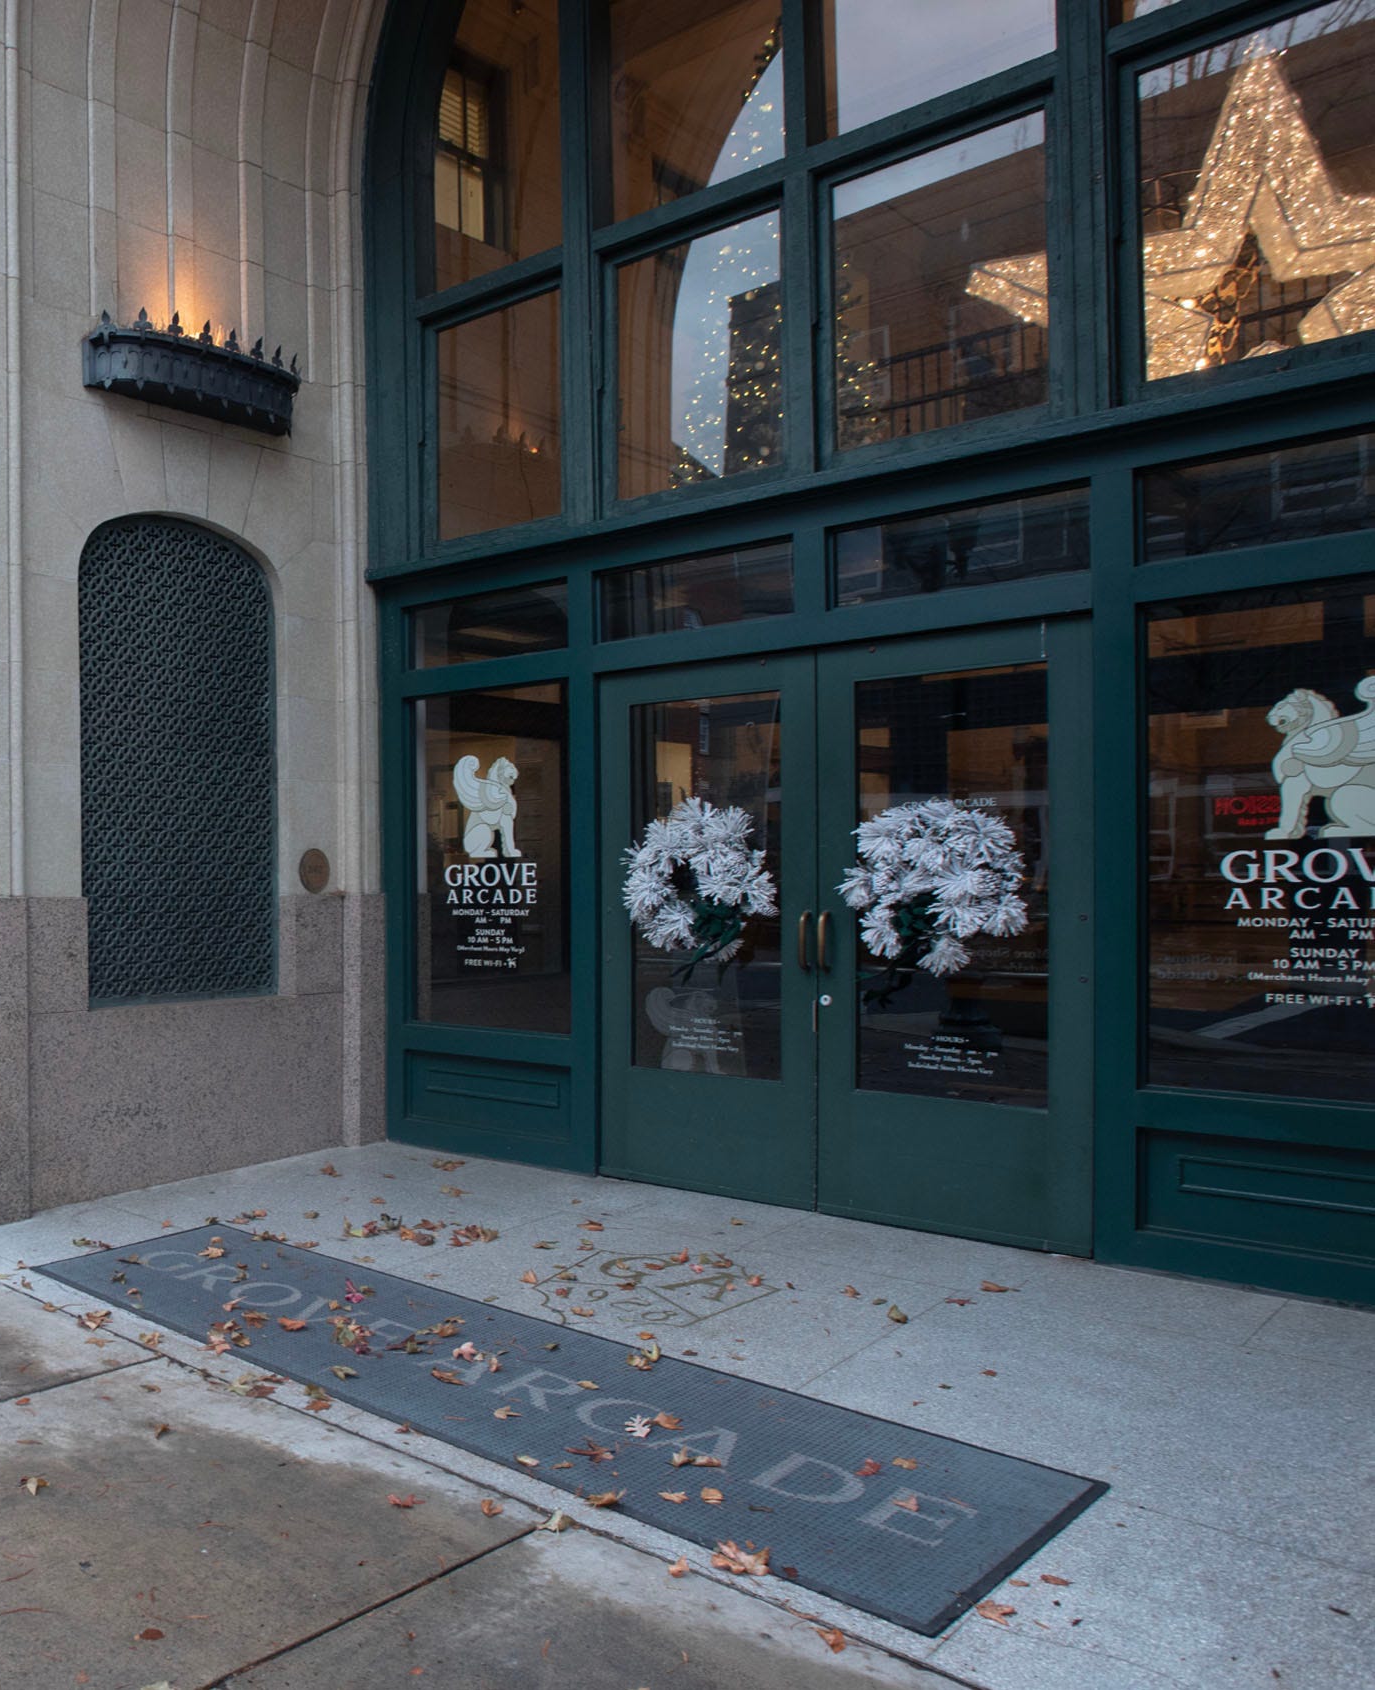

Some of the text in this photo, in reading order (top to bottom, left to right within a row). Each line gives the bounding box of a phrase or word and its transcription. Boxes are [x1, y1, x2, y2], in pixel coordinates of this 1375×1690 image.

[949, 797, 998, 808] RCADE
[444, 863, 537, 887] GROVE
[446, 889, 537, 904] ARCADE
[1223, 887, 1375, 910] ARCA
[1237, 917, 1310, 928] MONDAY
[1289, 929, 1374, 941] AM PM
[1290, 948, 1361, 959] SUNDAY
[464, 958, 502, 967] FREE WI-FI
[1273, 959, 1375, 971] 10 AM 5 PM
[1247, 971, 1371, 986] (Merchant Hours May
[1264, 993, 1352, 1006] FREE WI-FI
[935, 1035, 965, 1043] HOURS
[599, 1256, 744, 1303] GA
[413, 1356, 978, 1547] ARCADE
